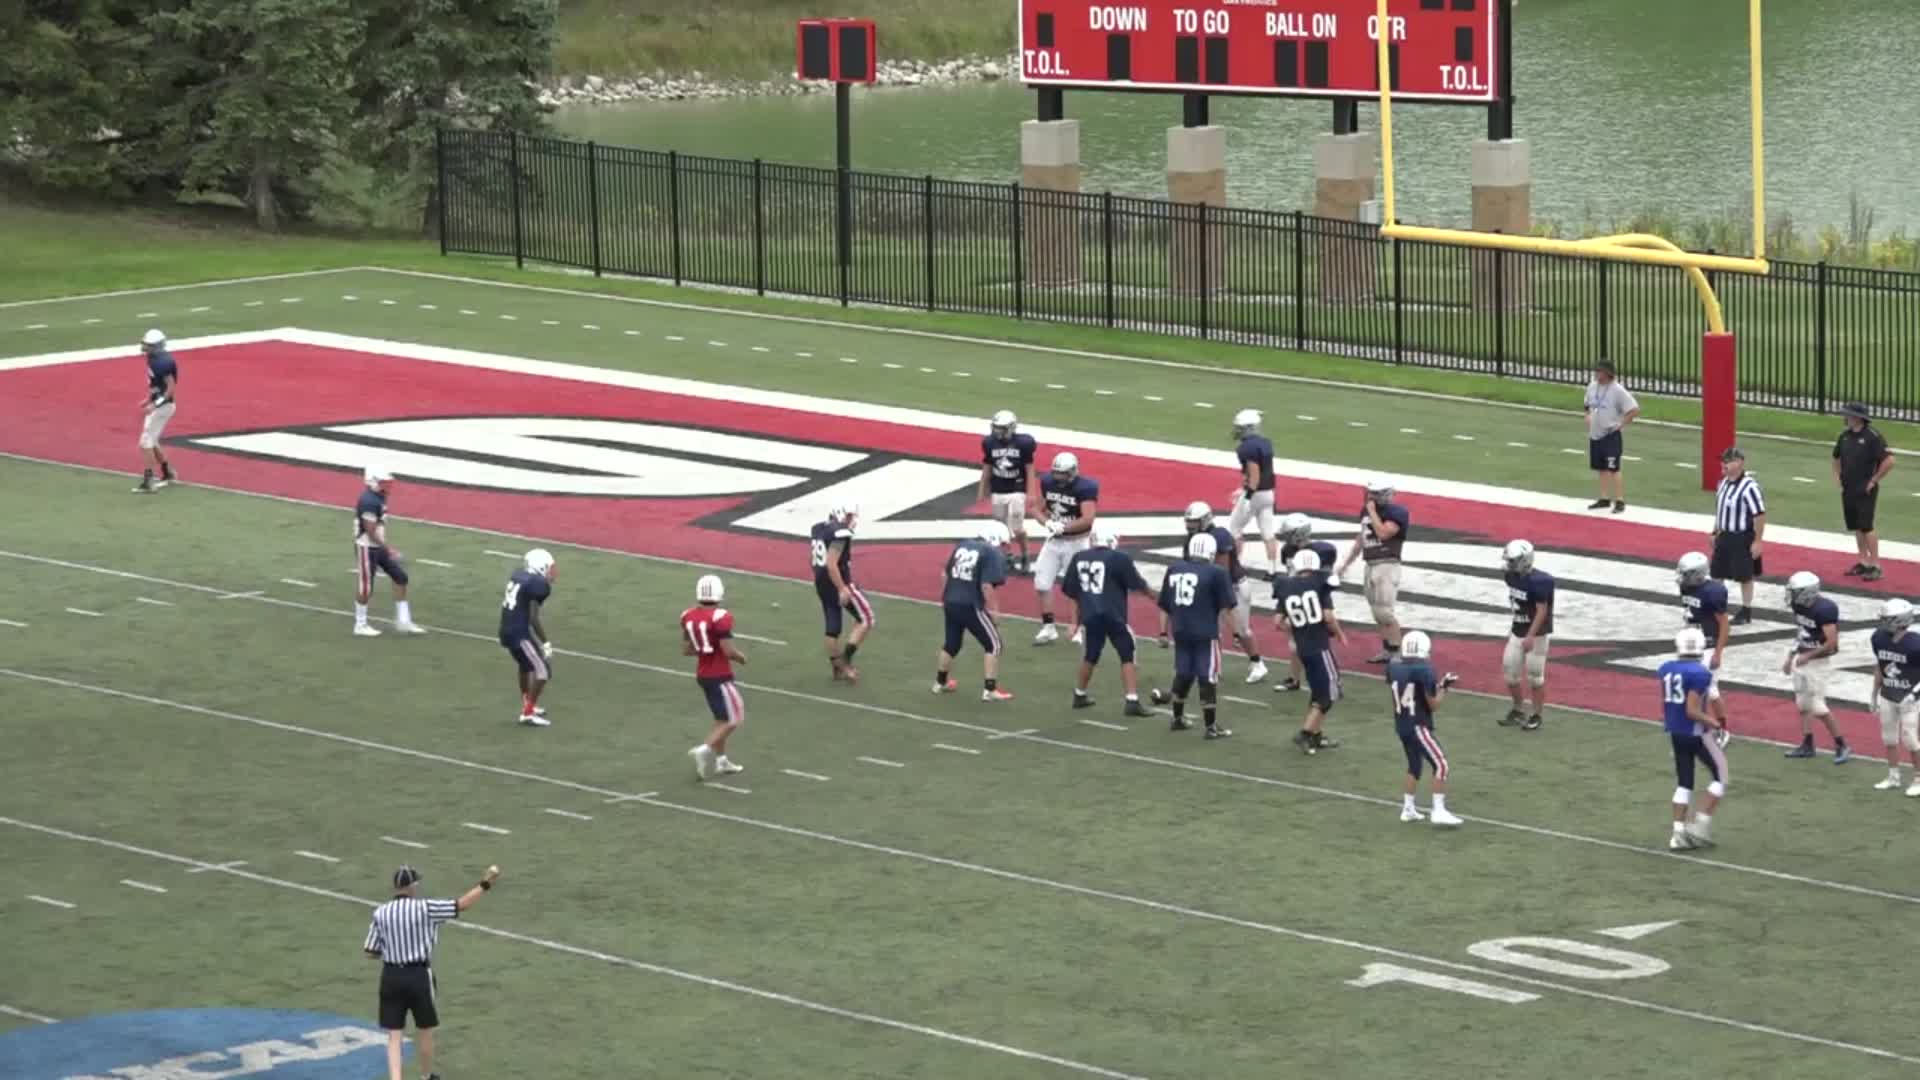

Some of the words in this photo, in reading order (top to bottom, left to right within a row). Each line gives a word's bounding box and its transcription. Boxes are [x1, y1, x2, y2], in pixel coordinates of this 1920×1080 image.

[1090, 6, 1147, 32] DOWN
[1174, 9, 1197, 33] TO
[1203, 10, 1229, 34] GO
[1266, 12, 1308, 37] BALL
[1312, 14, 1337, 38] ON
[1024, 49, 1070, 76] T.O.L.
[1440, 65, 1488, 92] T.O.L.
[1285, 590, 1323, 627] 60
[685, 621, 714, 653] 11
[1391, 680, 1417, 716] 14
[1663, 672, 1686, 704] 13
[1344, 936, 1671, 1003] 10
